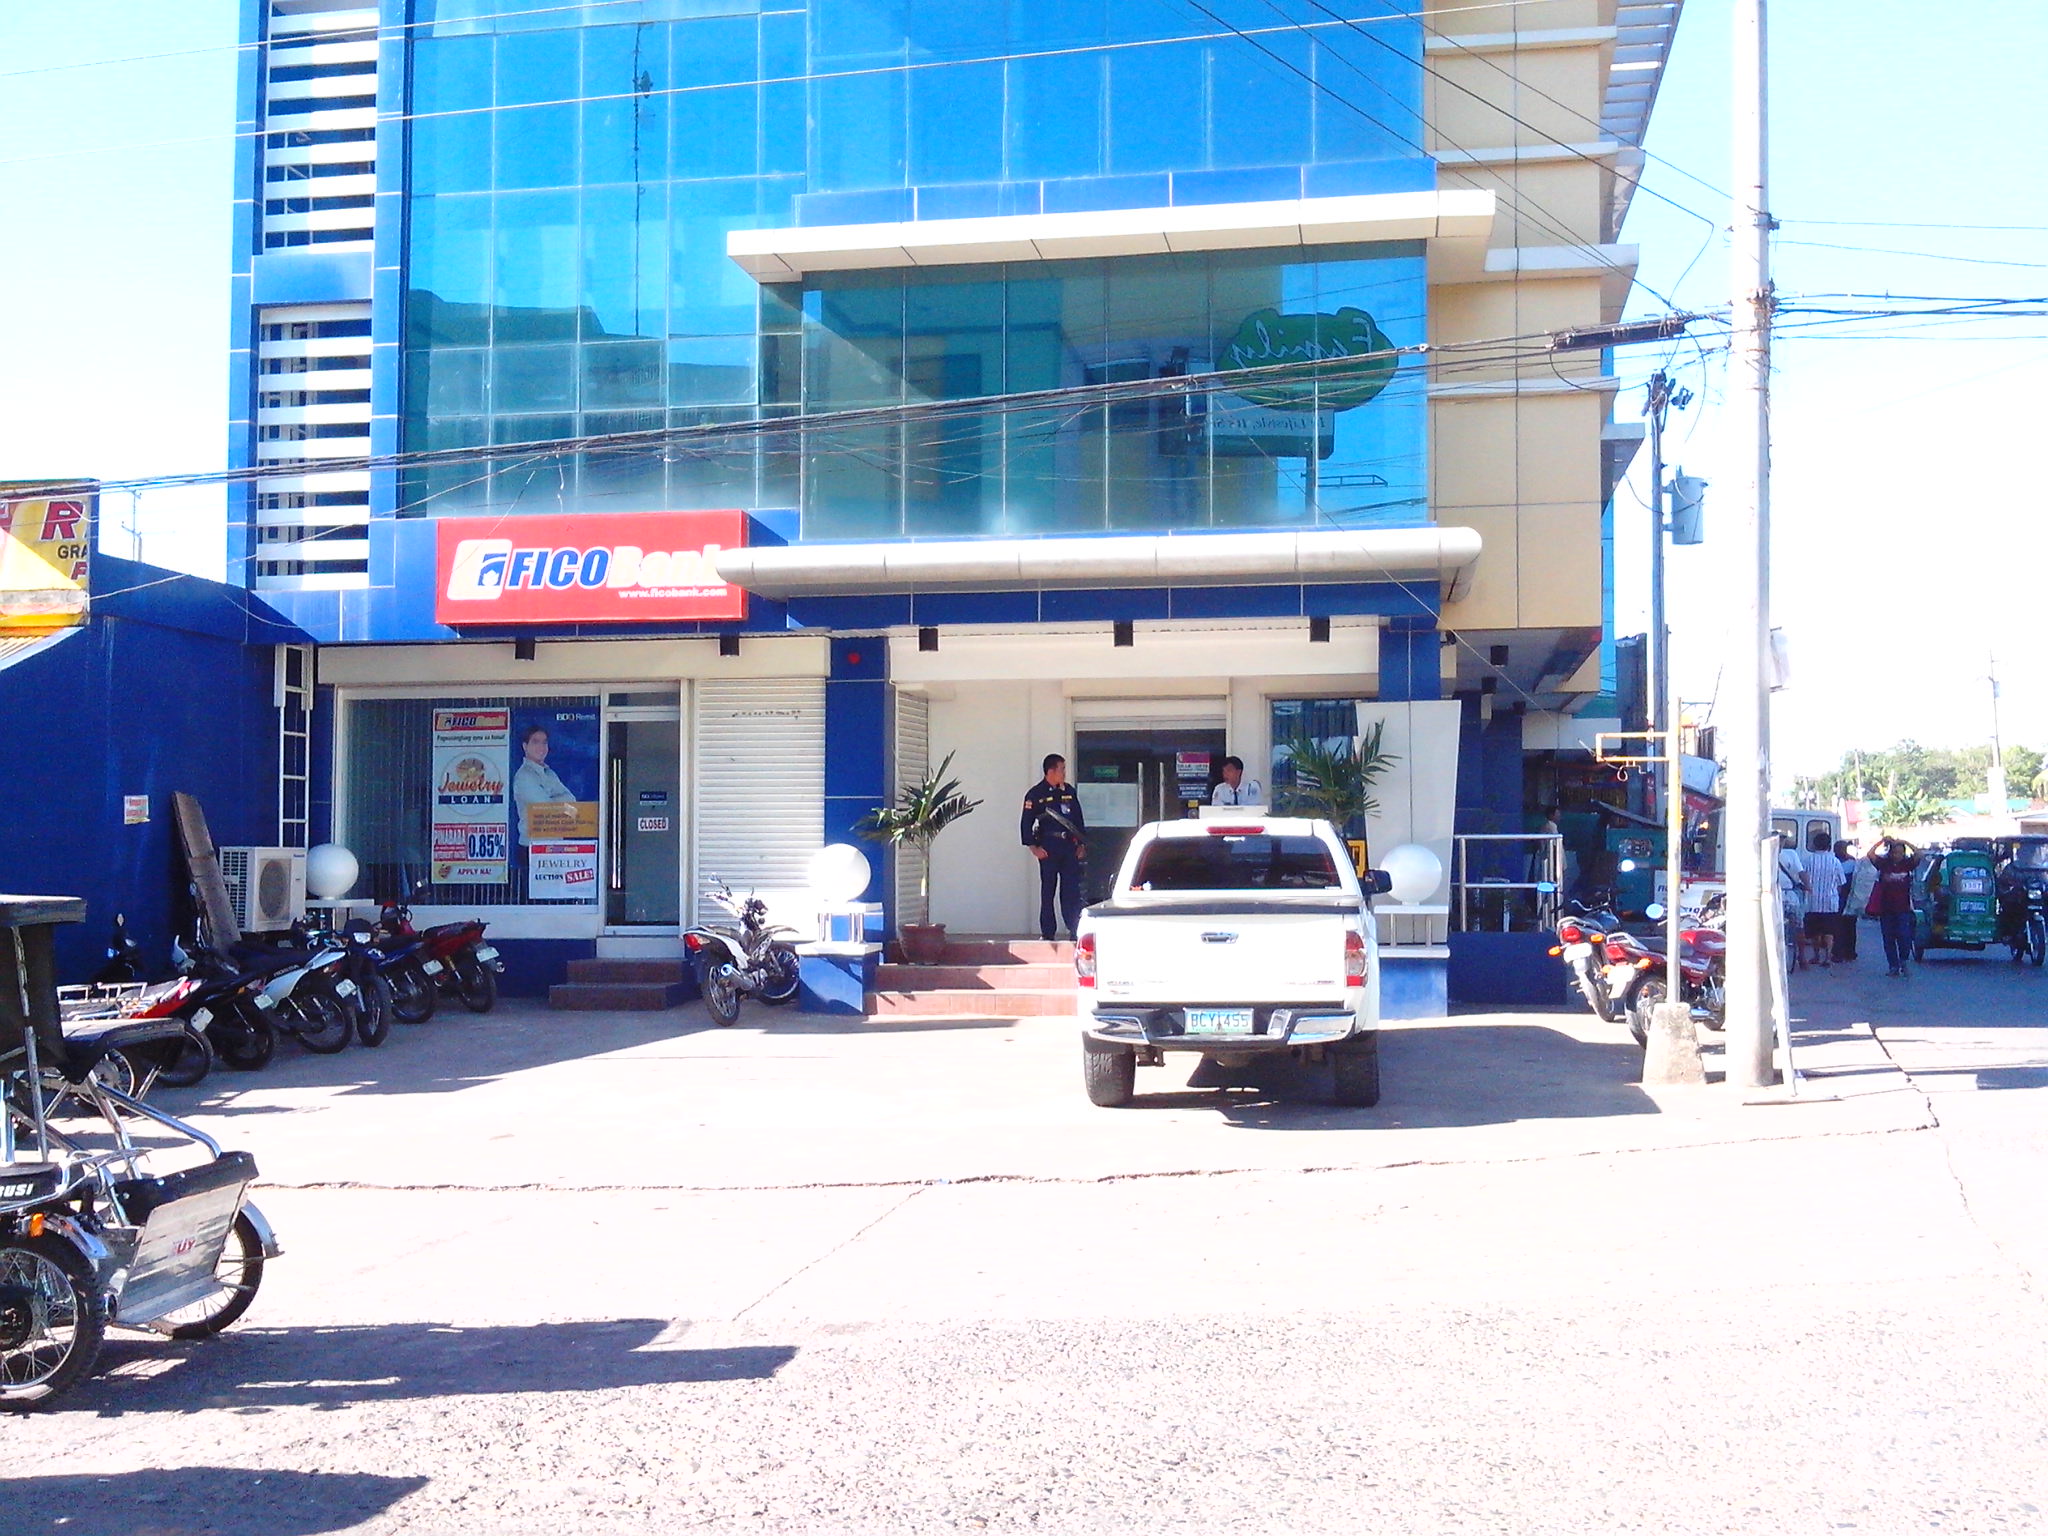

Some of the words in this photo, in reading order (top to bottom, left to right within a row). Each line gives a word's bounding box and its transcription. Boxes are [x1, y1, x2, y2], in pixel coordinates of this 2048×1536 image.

[618, 586, 728, 599] www.ficobank.com
[438, 772, 504, 796] Jewelry
[450, 795, 491, 804] LOAN
[640, 819, 667, 830] CLOSED
[468, 834, 505, 858] 0.85%
[538, 860, 587, 868] JEWELRY
[535, 873, 564, 881] AUCTION
[566, 870, 594, 883] SALE!
[1191, 1012, 1216, 1028] BCY
[1223, 1012, 1250, 1028] 455
